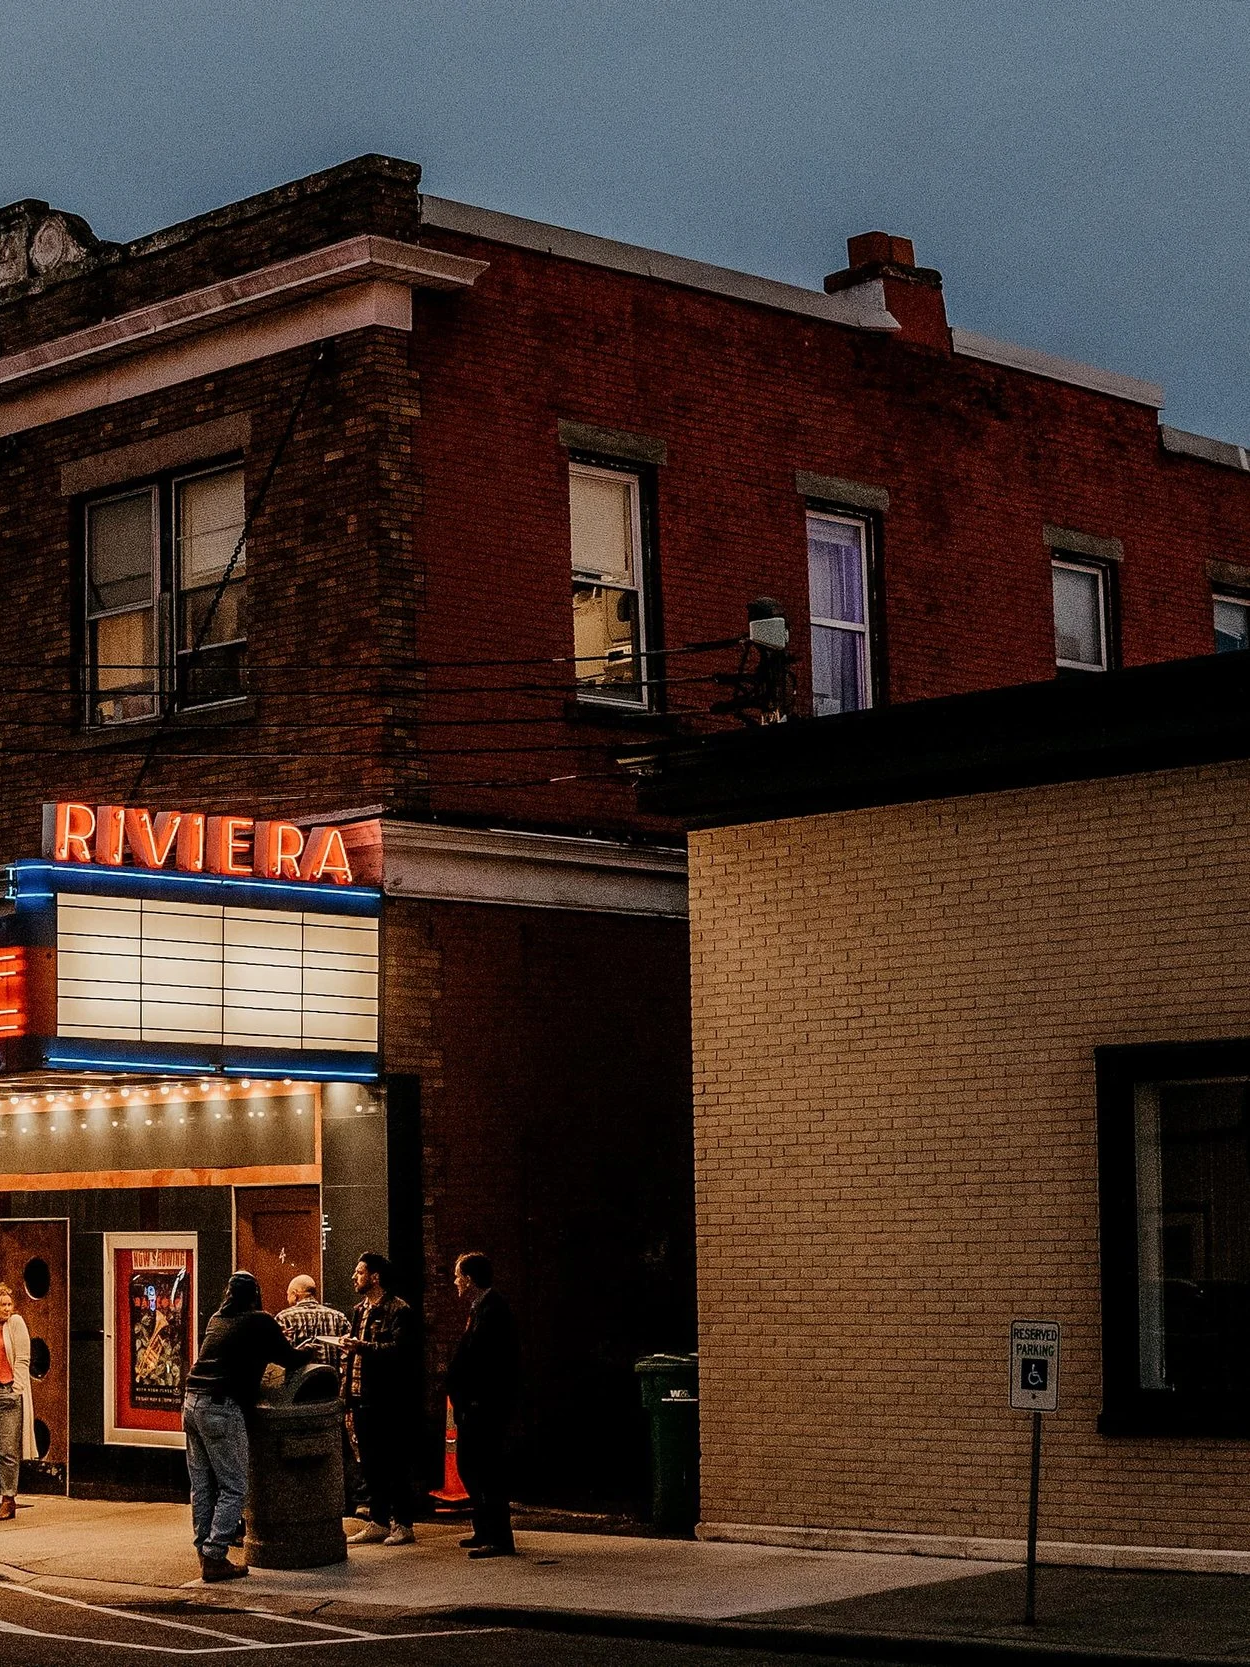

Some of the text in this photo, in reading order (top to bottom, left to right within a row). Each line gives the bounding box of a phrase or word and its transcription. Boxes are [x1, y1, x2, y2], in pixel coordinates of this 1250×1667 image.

[53, 802, 354, 885] RIVIERA
[133, 1251, 150, 1267] NOW
[1013, 1328, 1057, 1341] RESERVED
[1016, 1344, 1055, 1356] PARKING
